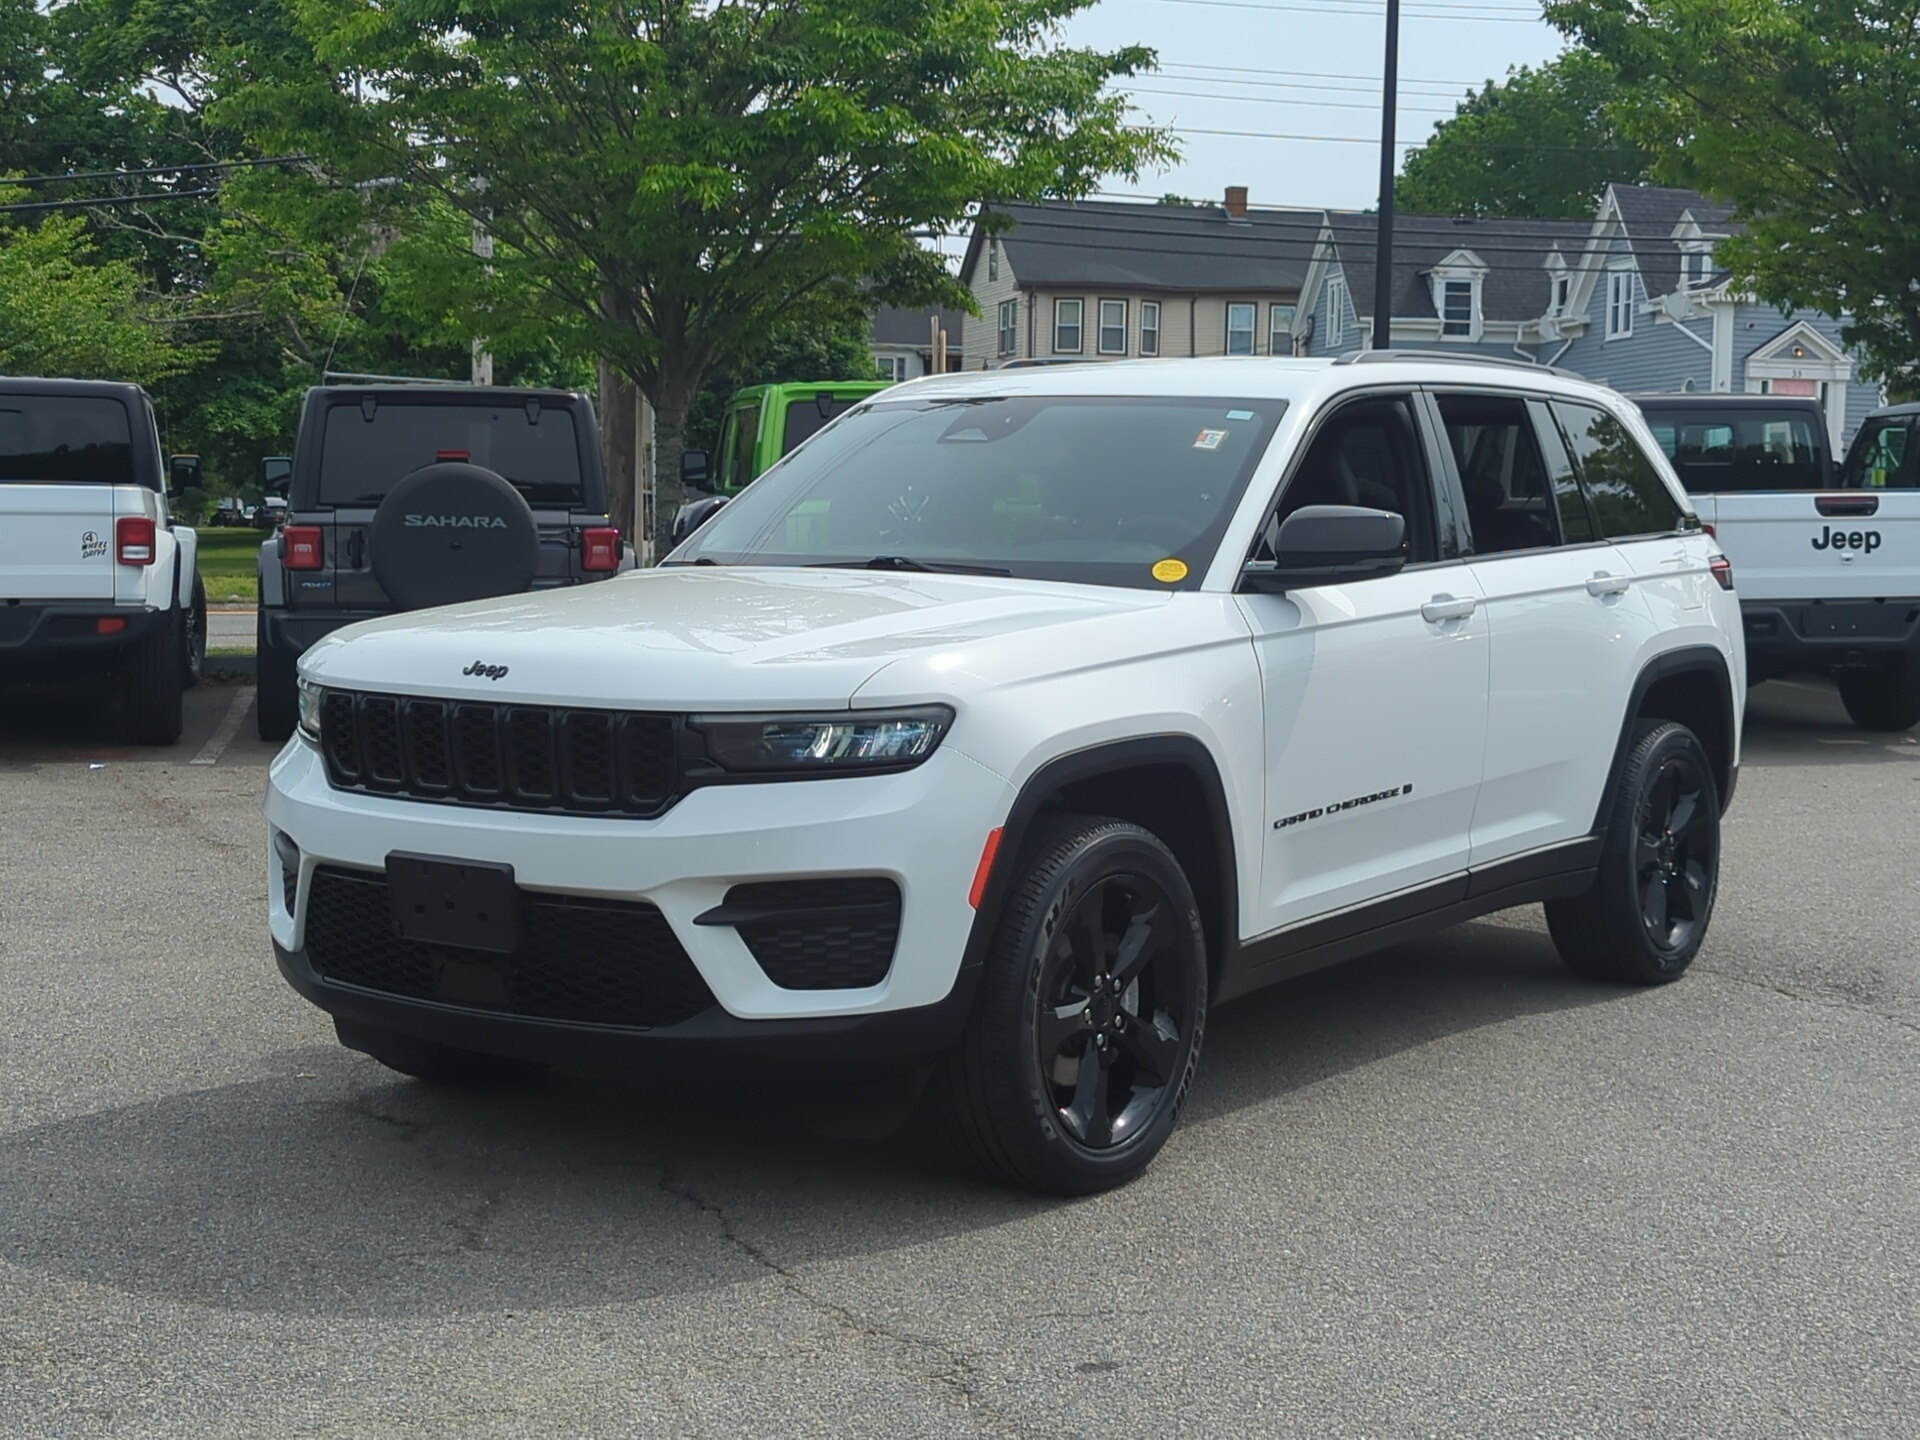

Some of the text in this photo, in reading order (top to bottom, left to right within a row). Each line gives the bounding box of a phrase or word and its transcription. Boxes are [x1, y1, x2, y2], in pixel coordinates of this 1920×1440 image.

[404, 514, 507, 528] SAHARA
[1811, 525, 1881, 554] Jeep
[463, 660, 509, 681] Jeep
[1273, 787, 1400, 829] GRAND CHEROKEE
